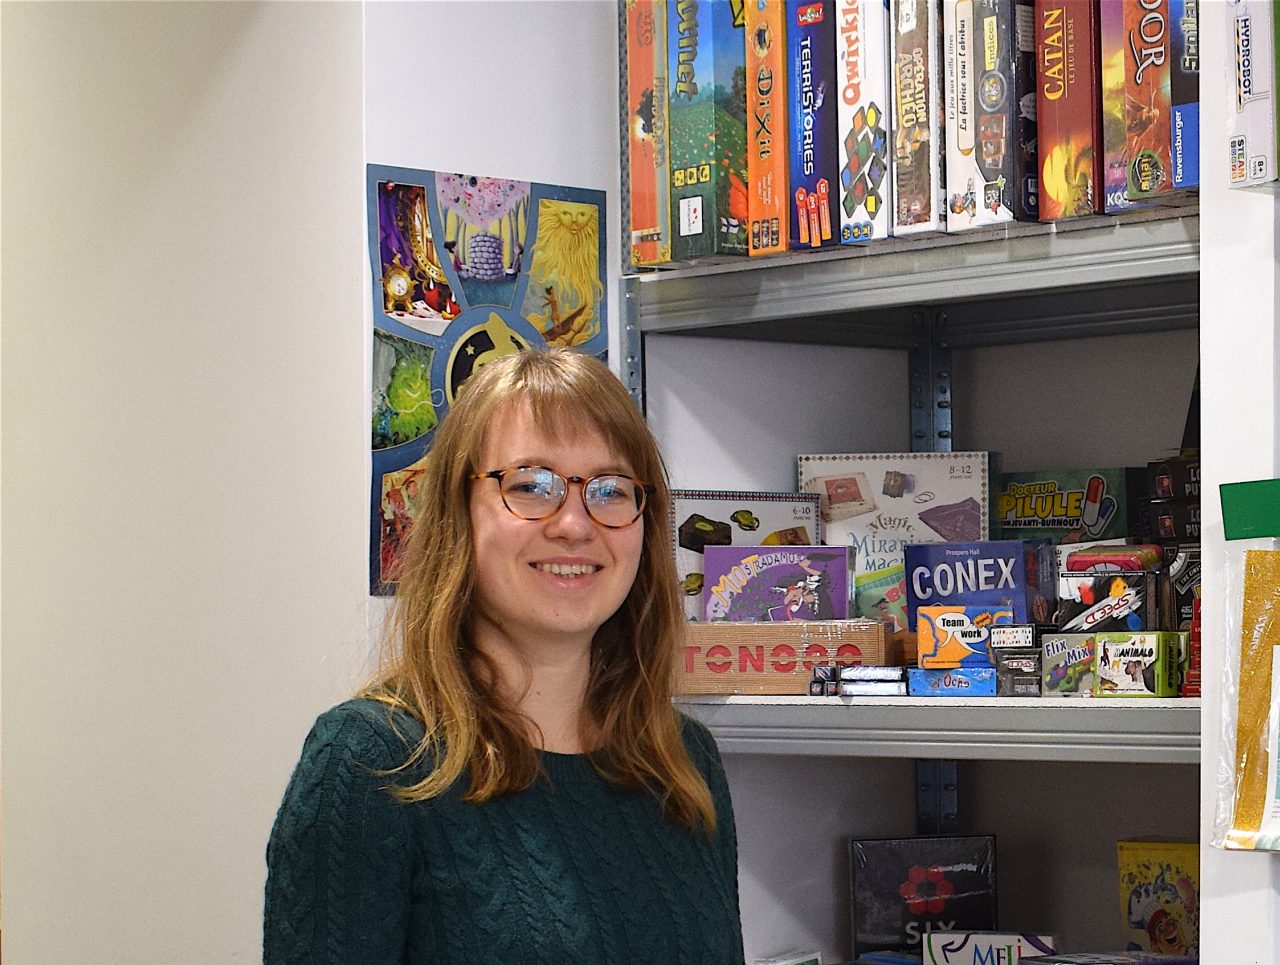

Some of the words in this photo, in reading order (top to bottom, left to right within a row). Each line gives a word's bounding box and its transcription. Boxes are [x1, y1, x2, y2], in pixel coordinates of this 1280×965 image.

[1044, 8, 1063, 100] CATAN
[1068, 42, 1075, 54] DE
[1240, 18, 1250, 95] HYDROBOT
[1069, 72, 1076, 84] LE
[1175, 110, 1184, 183] Ravensburger
[1236, 139, 1245, 179] STEAM
[1257, 159, 1264, 174] 8+
[950, 466, 972, 475] 8-12
[1009, 482, 1057, 497] DOCTEUR
[793, 506, 811, 515] 6-10
[1000, 491, 1084, 520] PILULE
[912, 557, 1016, 601] CONEX
[1084, 590, 1133, 626] SPEED
[941, 617, 965, 628] Team
[960, 629, 982, 639] work
[1045, 640, 1068, 658] Flix
[1066, 647, 1090, 666] Mix
